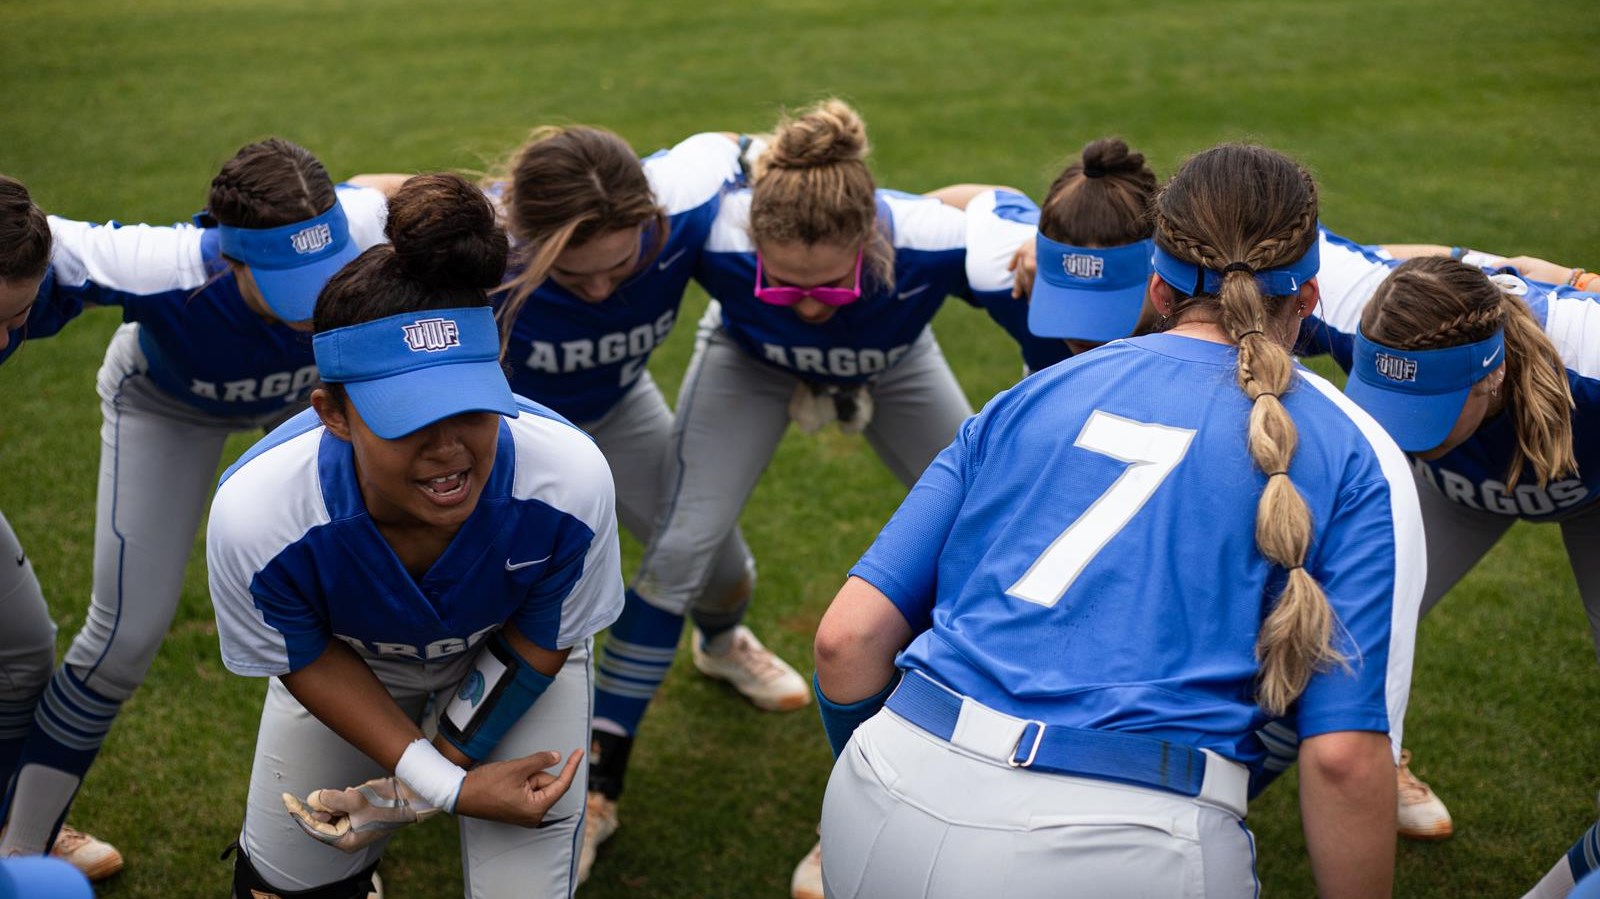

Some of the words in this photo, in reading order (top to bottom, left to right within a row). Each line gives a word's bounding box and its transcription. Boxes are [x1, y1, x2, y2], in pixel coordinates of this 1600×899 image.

[290, 223, 332, 254] UWF
[1063, 253, 1104, 280] UWF
[401, 318, 460, 352] UWF
[1376, 353, 1417, 382] UWF
[1004, 409, 1198, 608] 7
